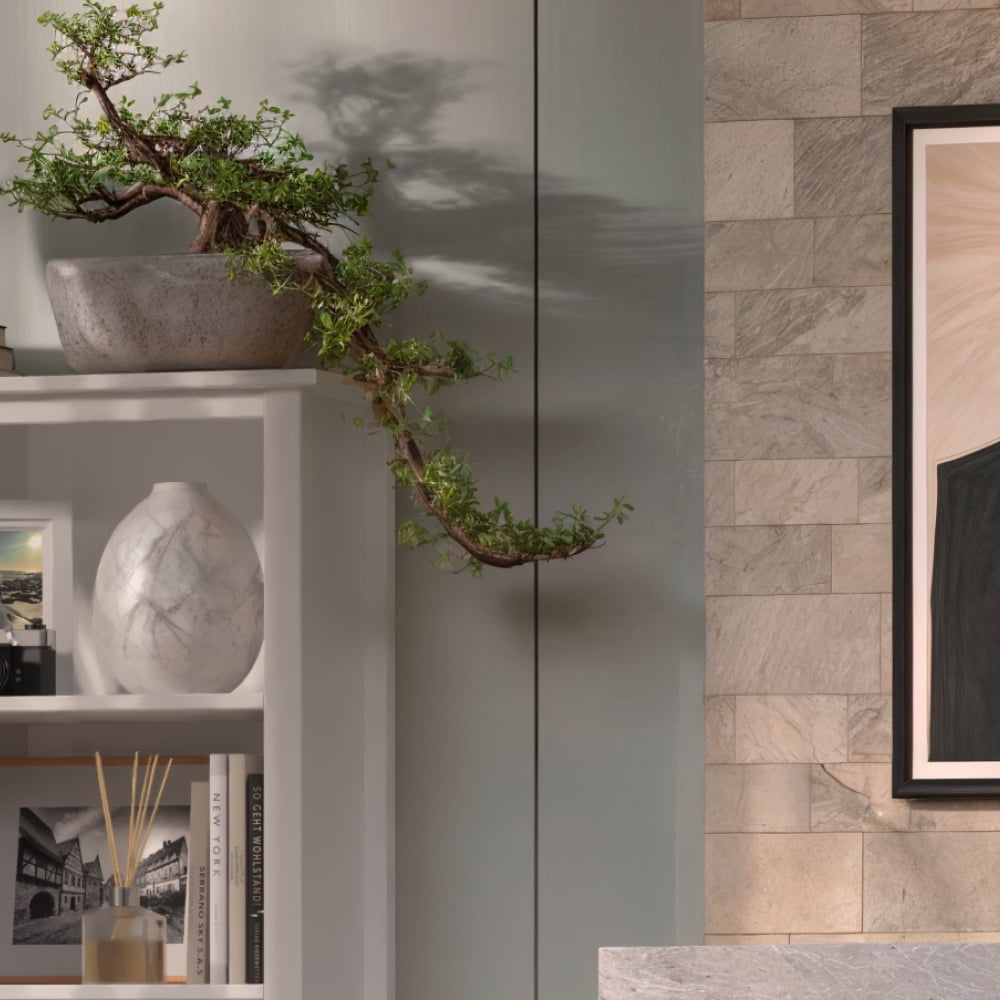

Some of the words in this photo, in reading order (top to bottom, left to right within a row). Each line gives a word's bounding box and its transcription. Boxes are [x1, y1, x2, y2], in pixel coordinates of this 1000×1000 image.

[252, 785, 262, 801] SO
[212, 793, 221, 827] NEW
[252, 804, 262, 832] GEHT
[212, 836, 221, 877] YORK
[252, 835, 262, 906] WOHLSTAND!
[197, 922, 205, 944] SKY
